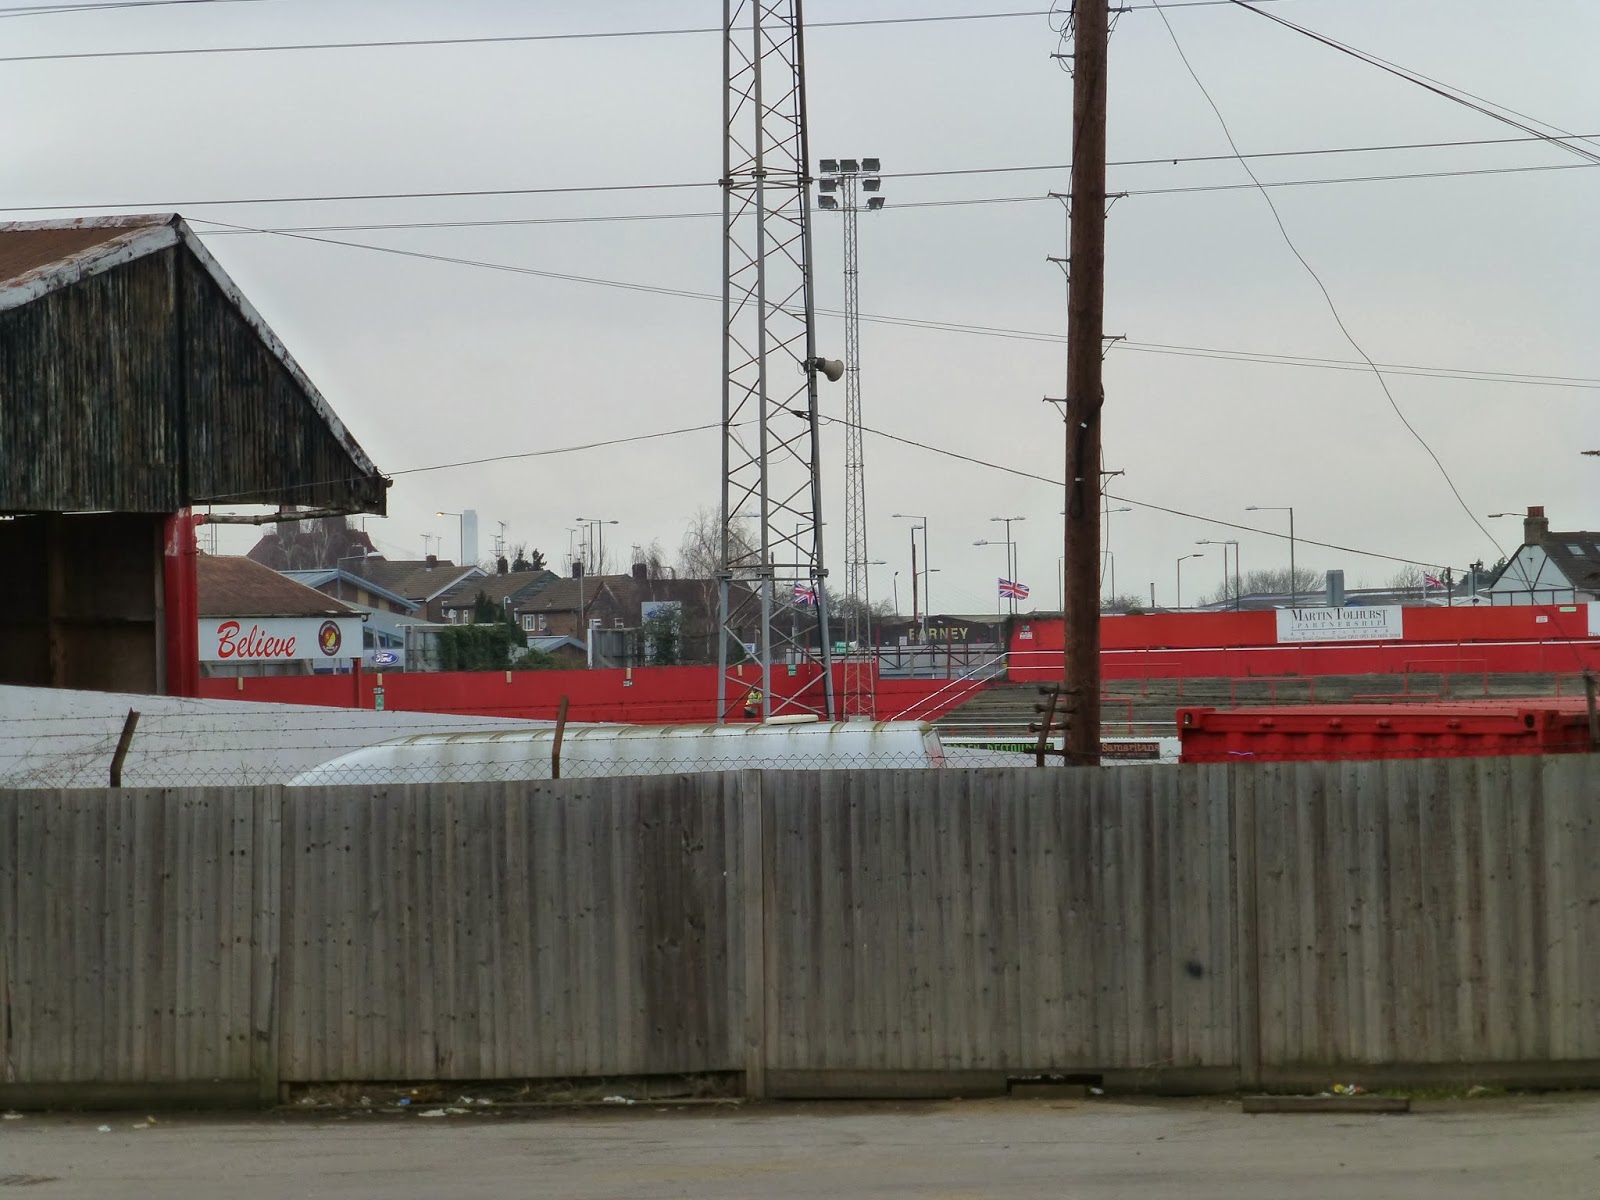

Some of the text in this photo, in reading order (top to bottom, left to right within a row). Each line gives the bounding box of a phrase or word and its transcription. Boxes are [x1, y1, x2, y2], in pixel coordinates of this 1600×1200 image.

[1292, 608, 1388, 625] MARTIN TOLHURST
[1297, 620, 1382, 629] PARTNERSHIP
[216, 620, 296, 658] Believe
[1102, 743, 1160, 752] Samaritans
